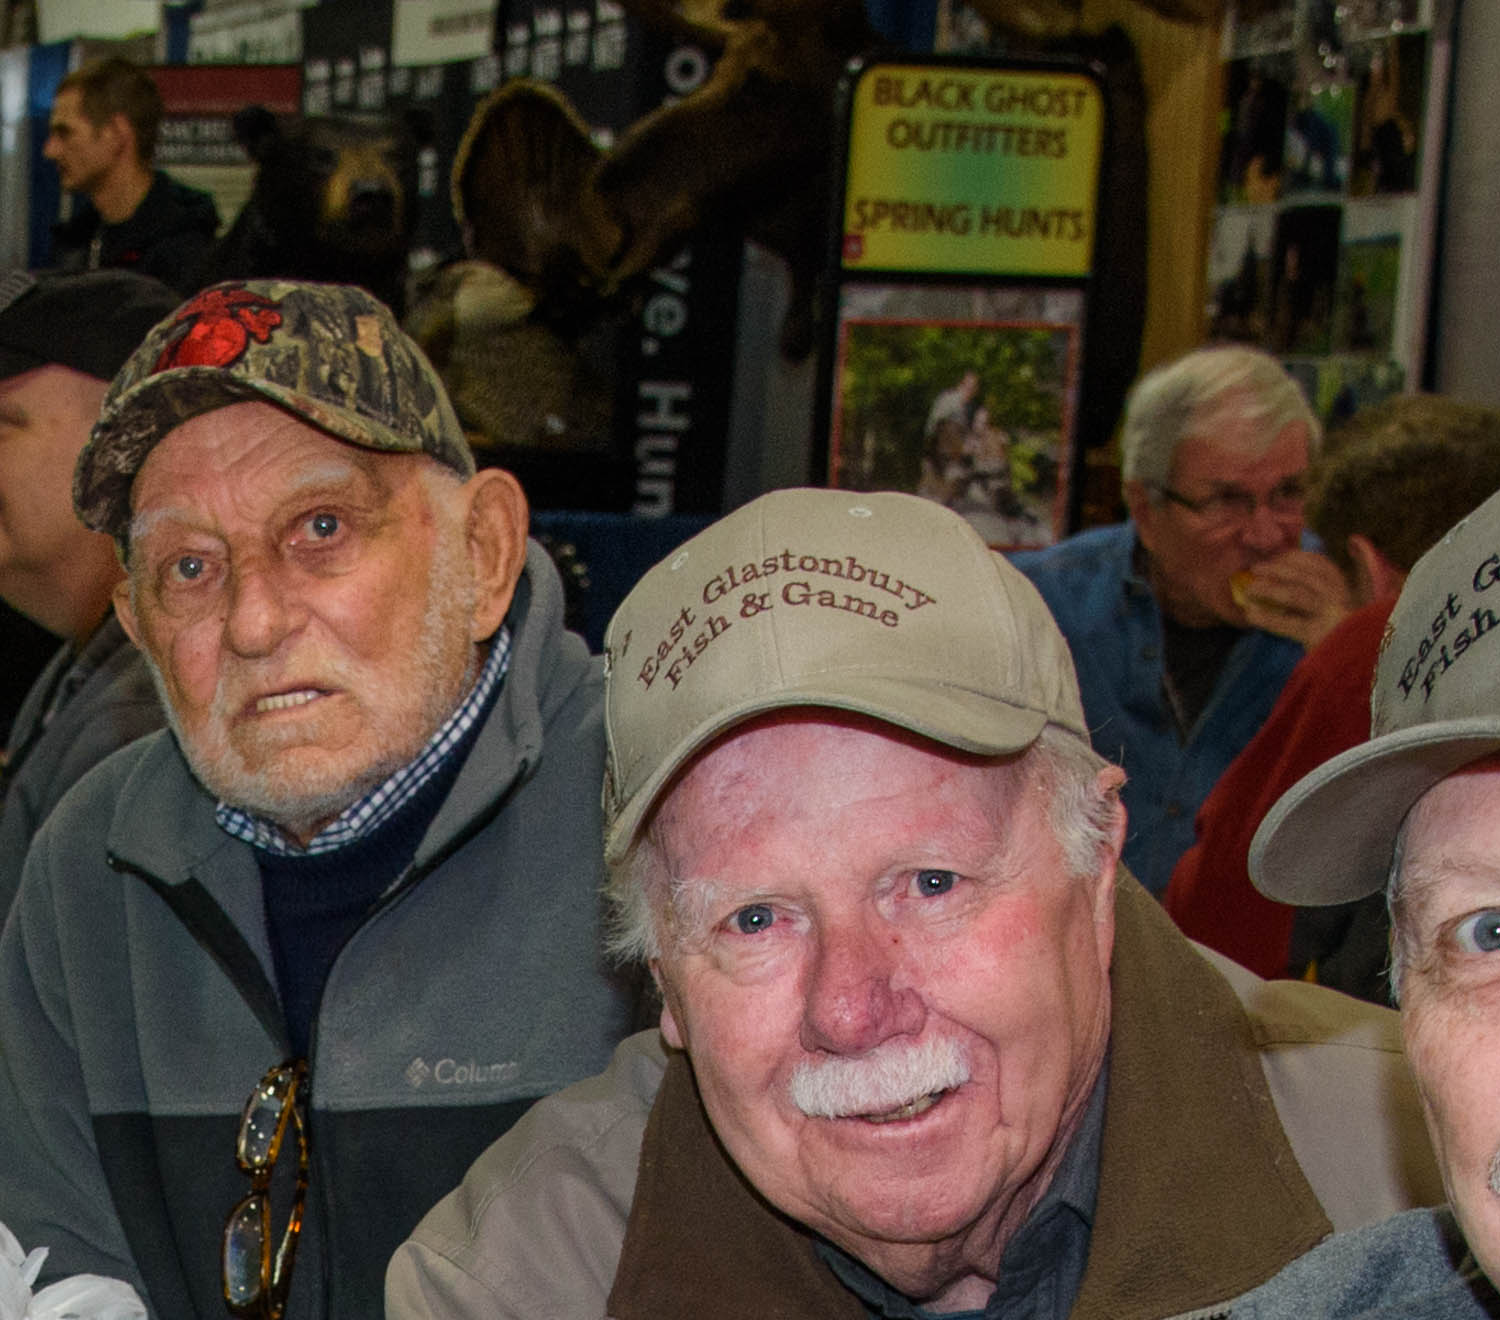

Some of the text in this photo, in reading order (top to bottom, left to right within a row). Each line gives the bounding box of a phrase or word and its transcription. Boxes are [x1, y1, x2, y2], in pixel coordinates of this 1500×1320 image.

[874, 74, 1088, 118] BLACK GHOST
[886, 118, 1068, 158] OUTFITTERS
[854, 200, 1085, 242] SPRING HUNTS
[636, 546, 938, 691] East Glastonbury
[664, 580, 901, 691] Fish & Game
[1396, 592, 1463, 702] East
